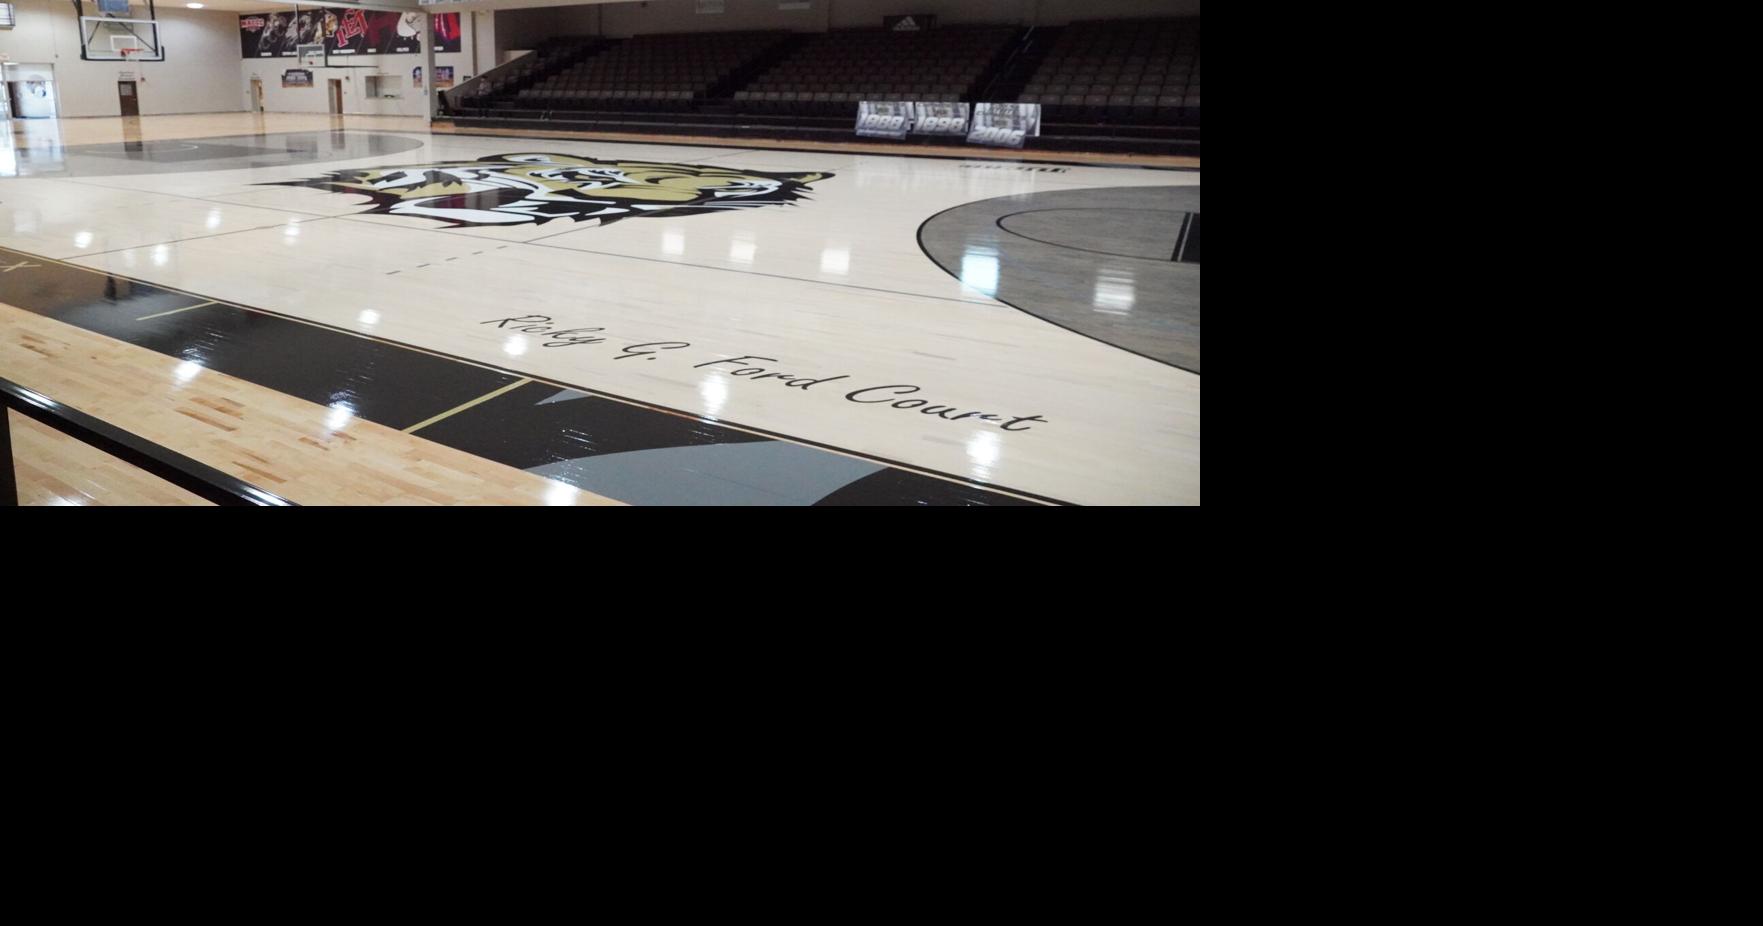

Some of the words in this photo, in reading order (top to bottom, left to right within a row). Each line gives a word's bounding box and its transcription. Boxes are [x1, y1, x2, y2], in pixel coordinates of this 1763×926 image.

[968, 126, 1025, 145] 2006
[480, 314, 607, 348] Ricky
[613, 341, 691, 361] G.
[693, 355, 850, 391] Ford
[845, 384, 1049, 432] Court
